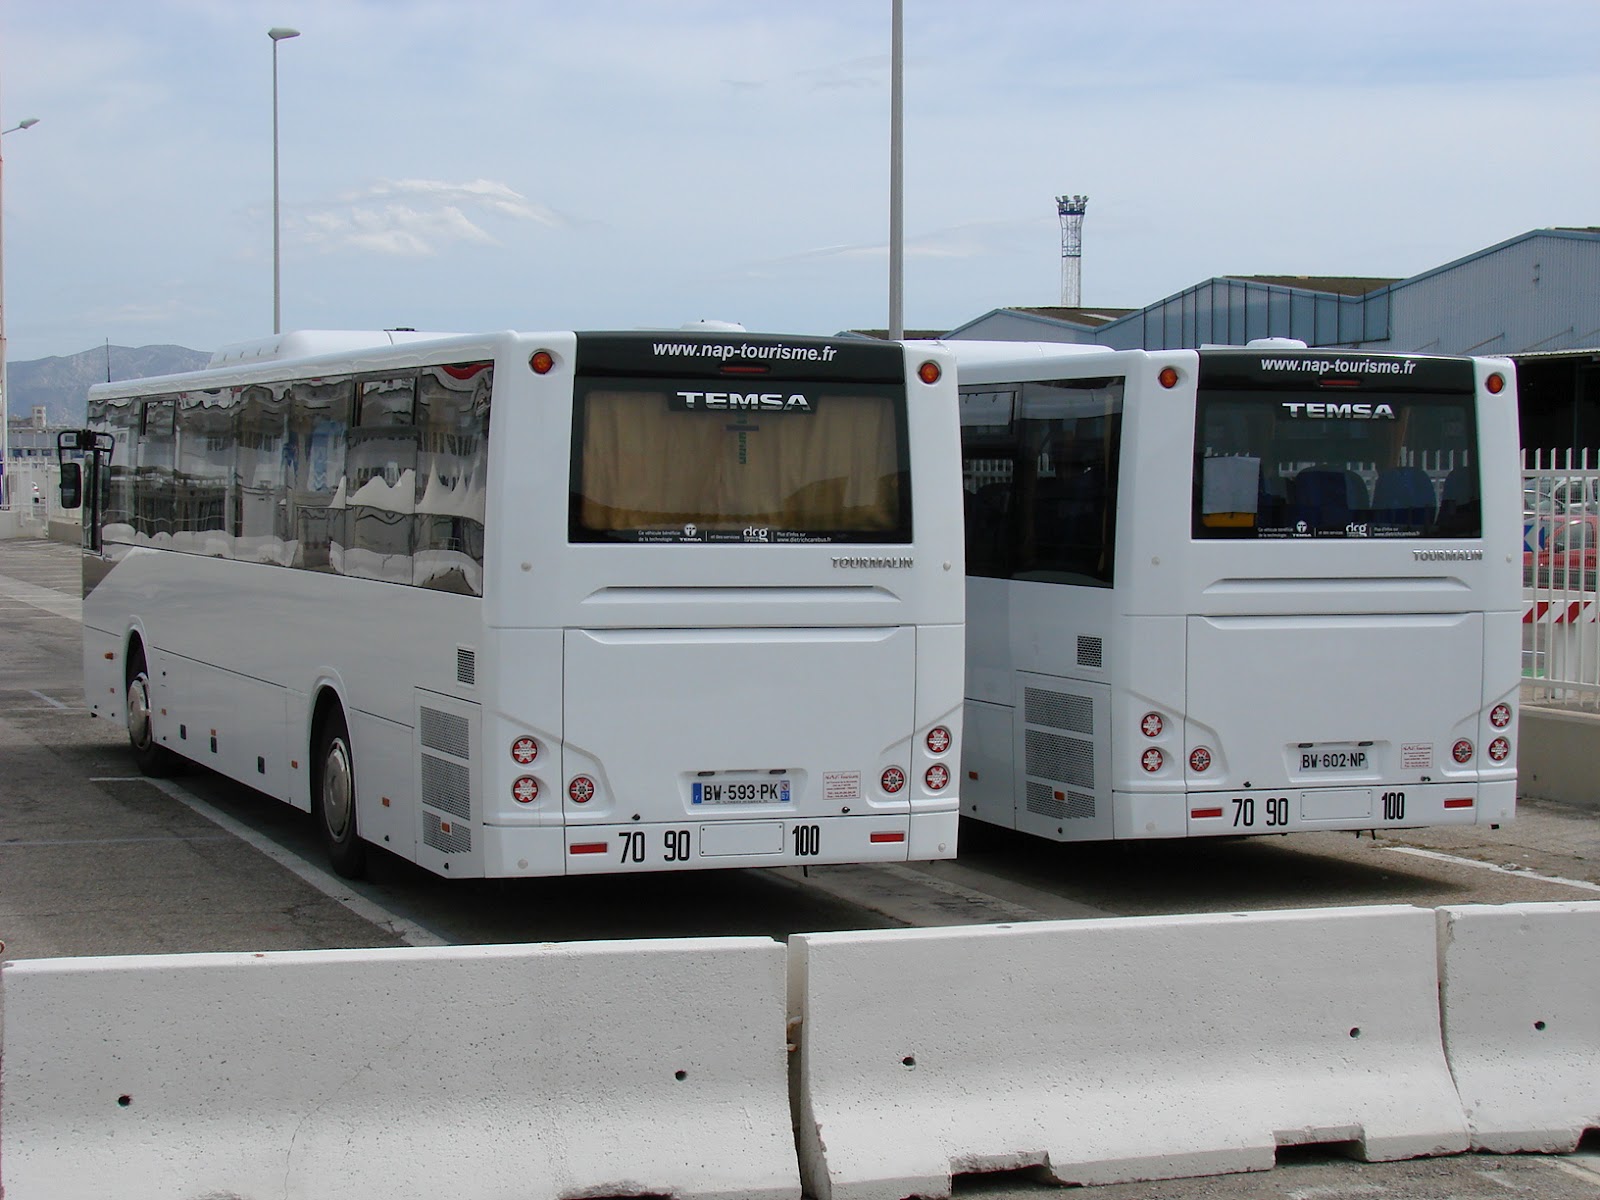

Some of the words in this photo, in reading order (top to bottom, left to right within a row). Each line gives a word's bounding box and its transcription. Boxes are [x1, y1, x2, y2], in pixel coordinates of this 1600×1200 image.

[652, 342, 836, 362] www.nap-tourisme.fr
[1261, 358, 1416, 375] www.nap-tourisme.fr
[676, 391, 812, 411] TEMSA
[1282, 402, 1396, 420] TEMSA
[831, 556, 914, 569] TOURMALIN
[1413, 549, 1483, 561] TOURMALIN
[1302, 752, 1366, 769] BW-602-NP
[703, 783, 778, 801] BW-593-PK
[1231, 798, 1254, 827] 70
[1266, 797, 1289, 826] 90
[1381, 792, 1405, 820] 100
[618, 831, 645, 864] 70
[663, 830, 691, 862] 90
[792, 825, 820, 856] 100
